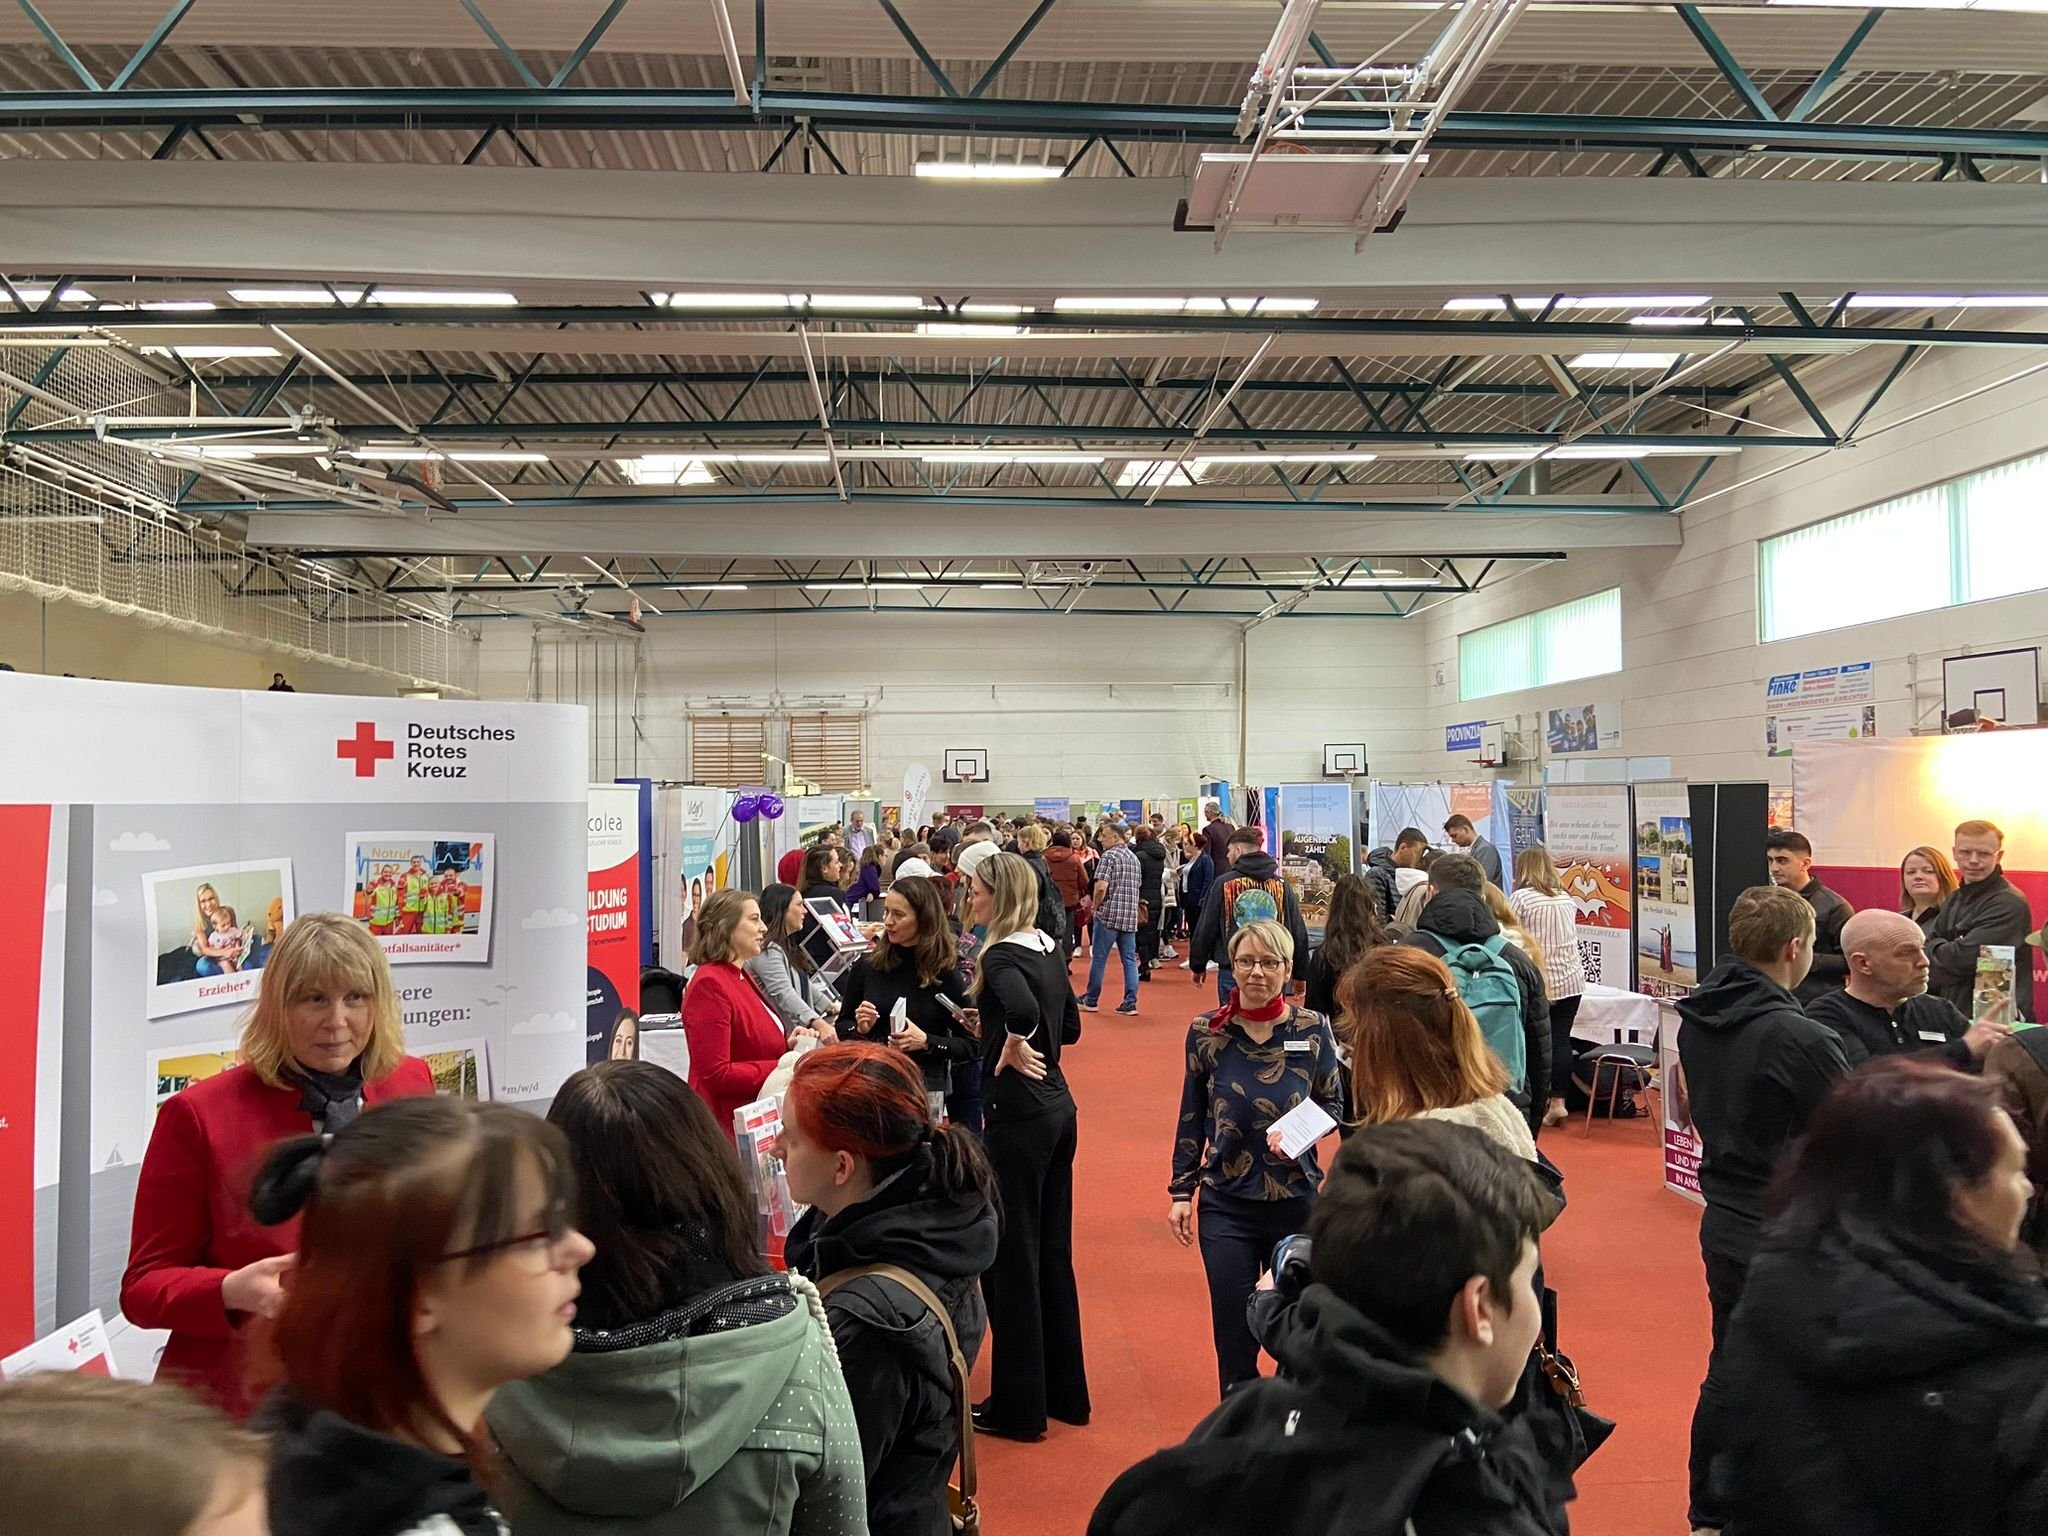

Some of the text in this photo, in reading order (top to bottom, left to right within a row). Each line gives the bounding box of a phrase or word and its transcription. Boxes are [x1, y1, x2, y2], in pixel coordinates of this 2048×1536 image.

[407, 723, 516, 741] Deutsches
[1447, 724, 1481, 743] PROVINZIA
[407, 742, 467, 759] Rotes
[407, 762, 467, 778] Kreuz
[587, 811, 622, 832] colea
[1294, 835, 1338, 844] AUGENBLICK
[372, 848, 412, 859] Notruf
[1305, 844, 1327, 854] ZÄHLT
[373, 863, 400, 876] 12
[588, 887, 628, 910] ILDUNG
[383, 943, 461, 954] otfallsanitäter
[404, 1008, 471, 1027] ungen:
[1673, 1134, 1693, 1149] LEBEN
[1674, 1153, 1690, 1167] UND
[1675, 1172, 1684, 1185] IN
